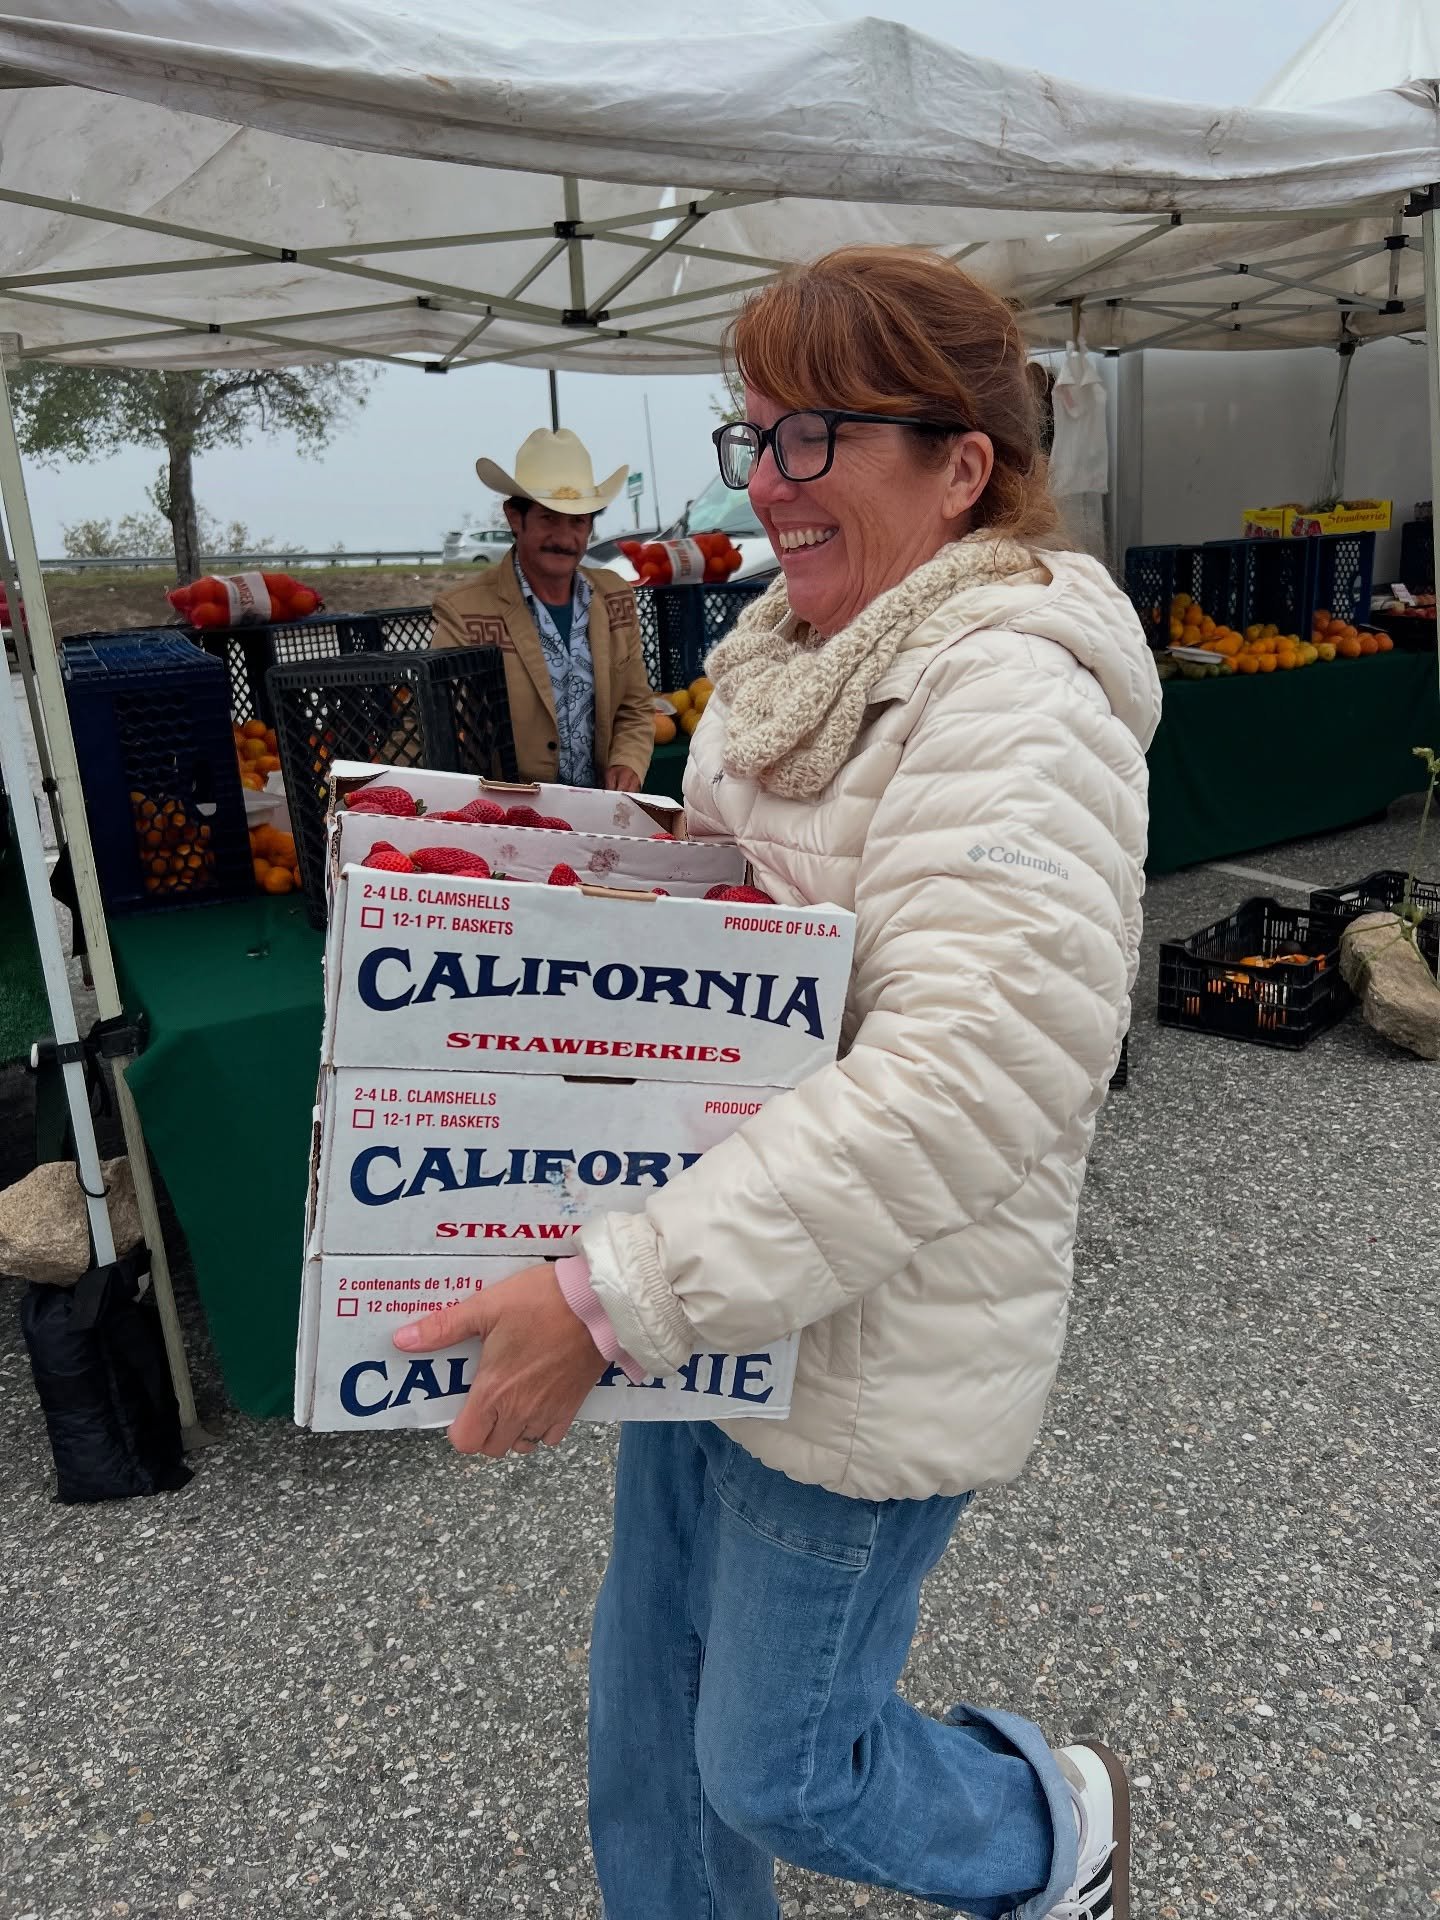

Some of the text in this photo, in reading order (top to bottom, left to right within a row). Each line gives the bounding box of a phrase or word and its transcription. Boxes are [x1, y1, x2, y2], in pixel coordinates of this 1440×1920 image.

[988, 846, 1069, 880] Columbia
[363, 884, 511, 911] 2-4 LB. CLAMSHELLS
[392, 912, 514, 936] 12-1 PT. BASKETS
[724, 916, 841, 938] PRODUCE OF U.S.A.
[357, 946, 823, 1040] CALIFORNIA
[446, 1031, 743, 1064] STRAWBERRIES
[354, 1087, 497, 1106] 2-4 LB. CLAMSHELLS
[382, 1112, 500, 1129] 12-1 PT. BASKETS
[349, 1144, 704, 1206] CALIFOR
[338, 1276, 483, 1292] 2 contenants de 1,81 g
[367, 1300, 382, 1313] 12
[385, 1299, 443, 1315] chopines
